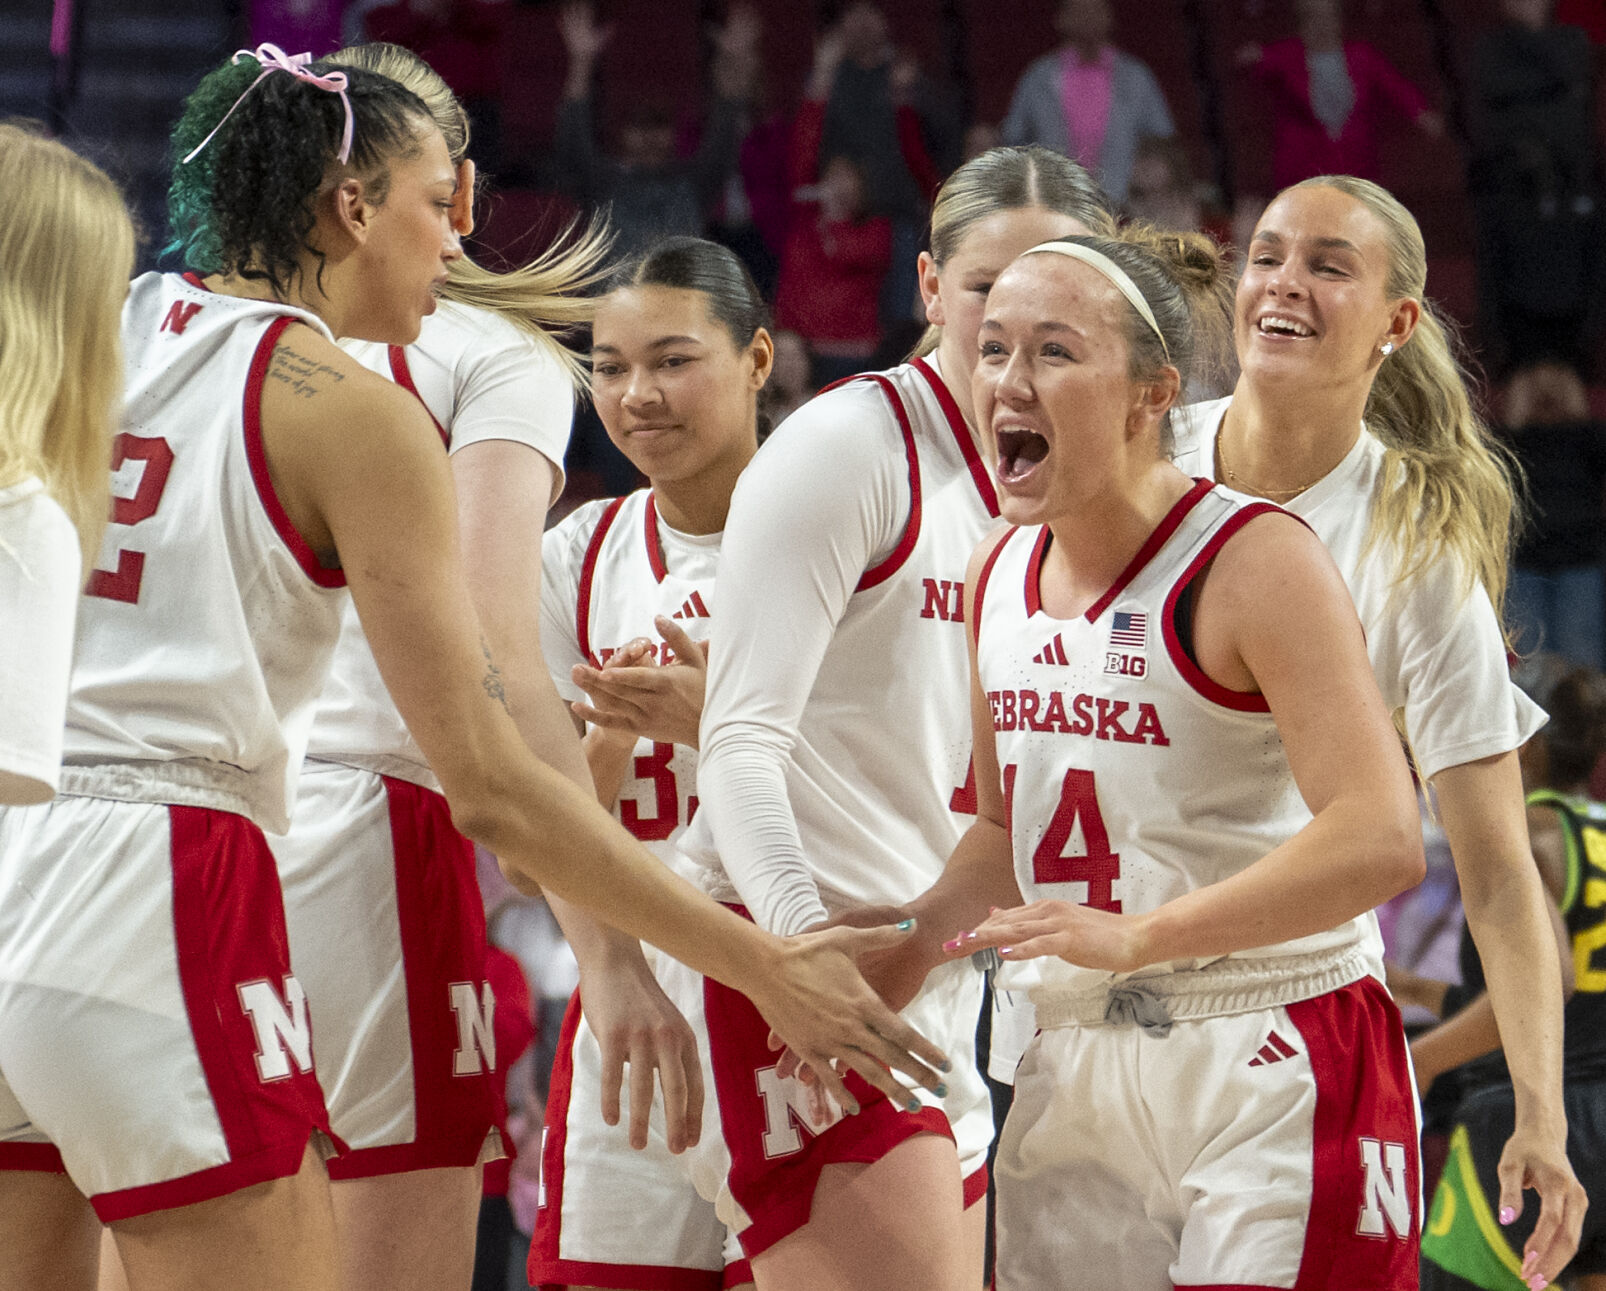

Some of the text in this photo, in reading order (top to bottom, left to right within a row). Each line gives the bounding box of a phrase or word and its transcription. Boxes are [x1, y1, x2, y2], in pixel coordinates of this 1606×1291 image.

[160, 299, 204, 335] N
[987, 689, 1170, 746] EBRASKA
[236, 973, 313, 1083] N
[448, 979, 496, 1077] N
[1356, 1137, 1411, 1239] N
